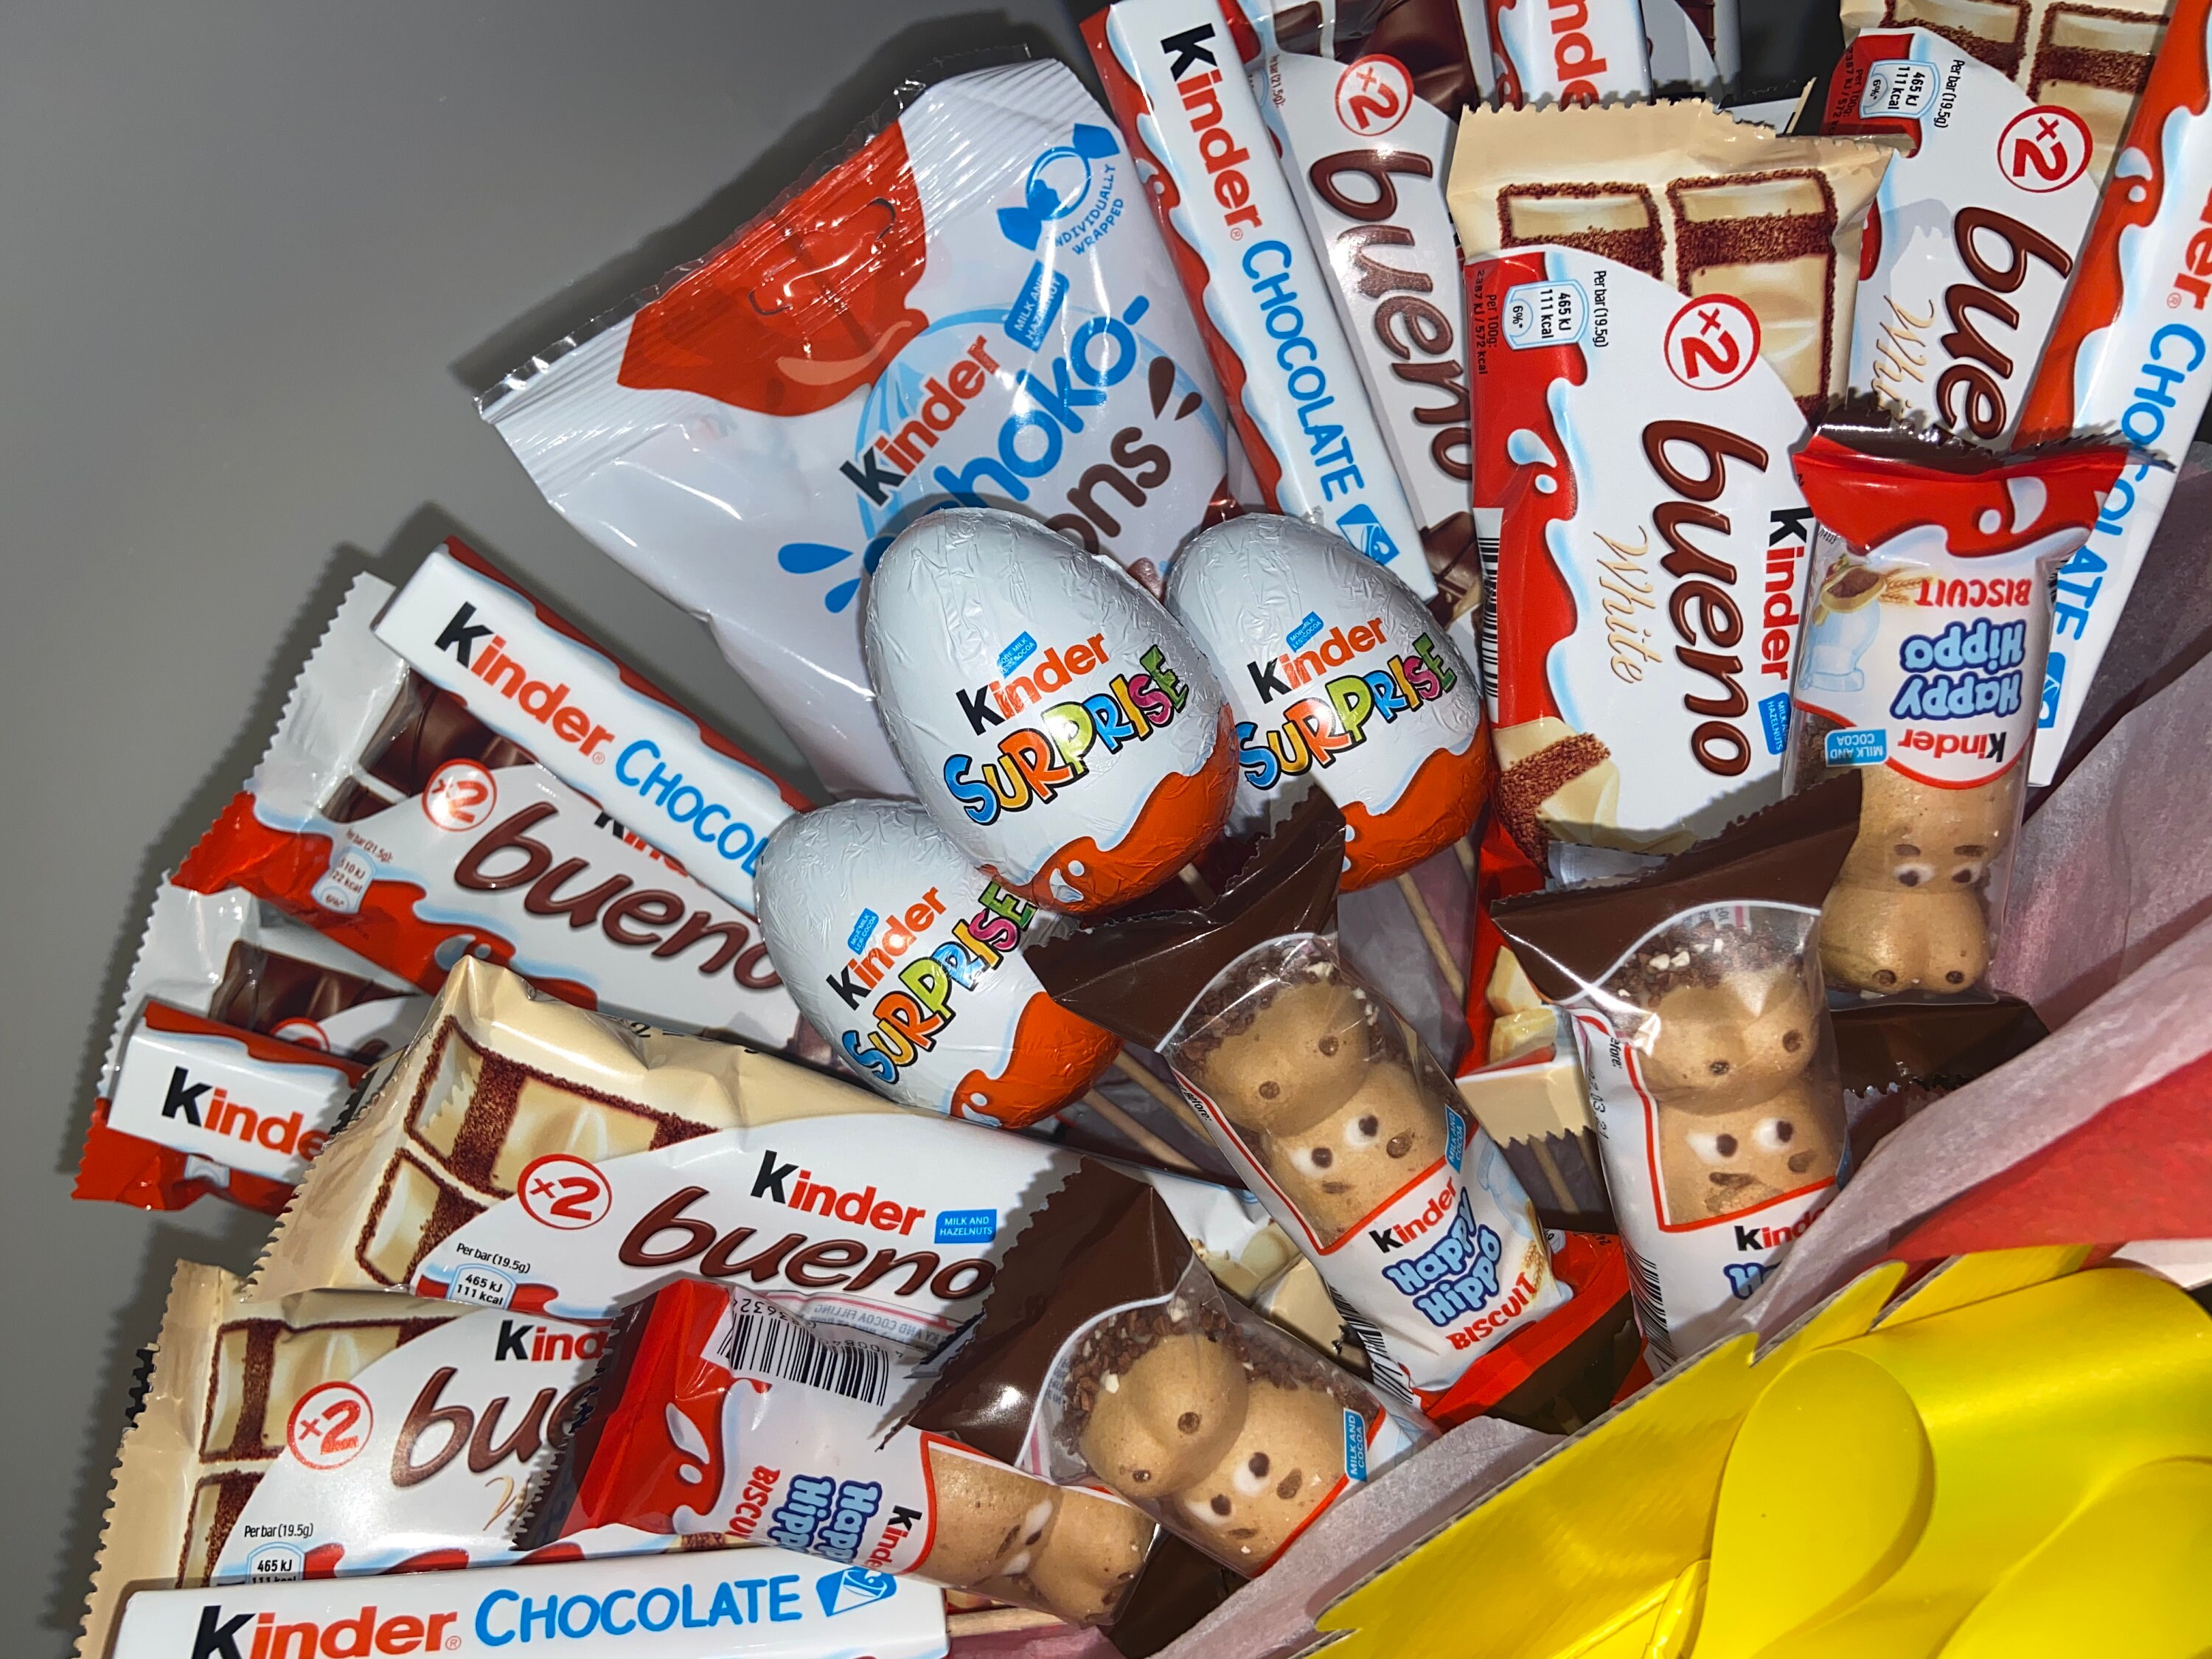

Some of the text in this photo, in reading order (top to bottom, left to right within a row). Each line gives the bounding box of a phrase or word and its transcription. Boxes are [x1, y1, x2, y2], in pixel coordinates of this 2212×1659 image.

[1888, 66, 1910, 110] 111 kcal
[1905, 72, 1925, 106] 465 kJ
[1933, 60, 1966, 128] Per bar (19.5g)
[1054, 164, 1116, 246] NDIVIDUALLY
[1072, 198, 1124, 255] WRAPPED
[1161, 23, 1365, 501] Kinder CHOCOLATE
[1474, 270, 1485, 301] 2387
[1014, 300, 1035, 331] MILK
[1025, 277, 1061, 341] HAZNUT
[1475, 324, 1486, 349] 572
[1486, 294, 1498, 349] per 100g:
[1540, 289, 1554, 339] 111 kcal
[1558, 293, 1571, 331] 465 kJ
[1593, 271, 1609, 348] Per bar (19.5g)
[1936, 207, 2073, 440] bue
[1477, 350, 1488, 375] kcal
[840, 335, 1001, 506] Kinder
[1593, 525, 1663, 684] White
[1641, 420, 1770, 776] bueno
[1760, 507, 1815, 681] Kinder
[1914, 579, 2032, 608] BISCUIT
[1302, 621, 1322, 638] COCOA
[1900, 617, 2027, 673] Hippo
[434, 602, 616, 757] Kinder
[956, 633, 1109, 736] Kinder
[1247, 617, 1387, 704] Kinder
[1234, 633, 1457, 790] SURPRISE
[1777, 700, 1787, 723] MILK
[1889, 669, 2023, 720] Happy
[944, 644, 1189, 826] SURPRISE
[1767, 700, 1784, 751] HAZELNUTS
[1830, 745, 1884, 759] MILK AND
[1836, 733, 1876, 746] COCOA
[1897, 728, 2007, 762] Kinder
[344, 877, 363, 893] kcal
[826, 887, 947, 1010] Kinder
[861, 916, 877, 937] COCOA
[842, 880, 1037, 1084] SURPRISE
[161, 1066, 332, 1162] Kinde
[751, 1150, 926, 1235] Kinder
[945, 1216, 990, 1225] MILK AND
[1368, 1177, 1458, 1253] Kinder
[619, 1186, 996, 1300] bueno
[939, 1226, 993, 1236] HAZELNUTS
[1382, 1187, 1478, 1295] Happy
[1734, 1208, 1825, 1251] Kind
[456, 1242, 531, 1274] Per bar (19.5g)
[465, 1274, 503, 1293] 465 kJ
[1412, 1223, 1502, 1327] Hippo
[457, 1284, 504, 1305] 111 kcal
[1446, 1273, 1538, 1351] BISCUIT
[495, 1320, 611, 1361] Kind
[1350, 1444, 1358, 1475] MILK
[1357, 1426, 1365, 1468] COCOA
[726, 1465, 781, 1538] BISCU
[767, 1474, 836, 1554] Hipp
[813, 1480, 883, 1564] Happ
[244, 1523, 314, 1539] Per bar (19.5g)
[864, 1505, 923, 1570] Kinde
[257, 1559, 293, 1572] 465 kJ
[191, 1574, 803, 1659] Kinder CHOCOLATE
